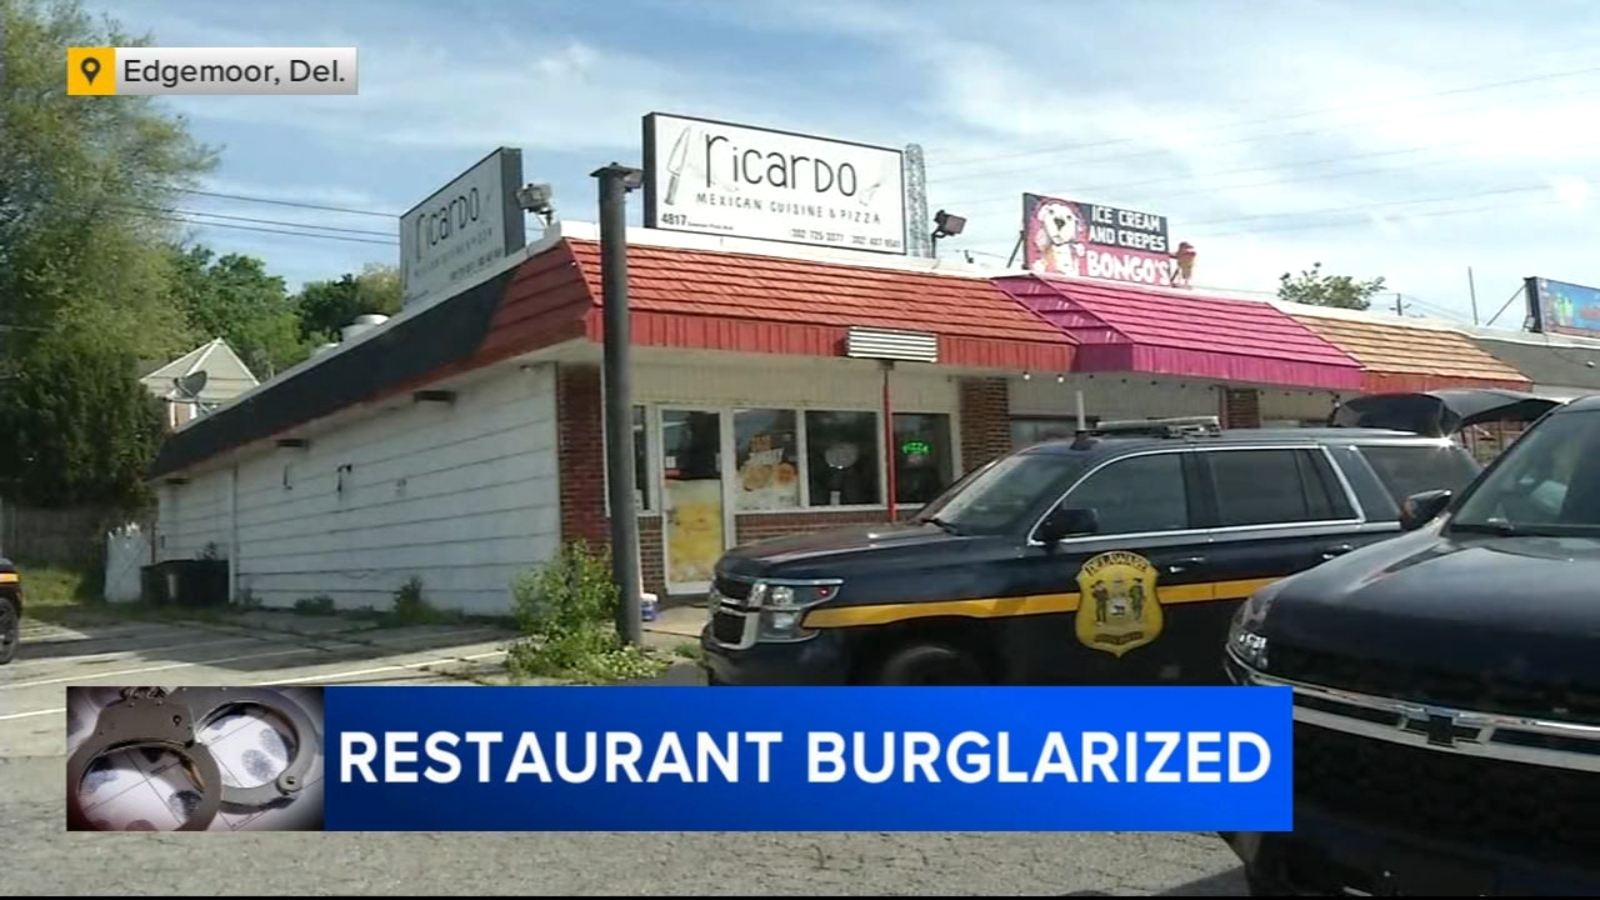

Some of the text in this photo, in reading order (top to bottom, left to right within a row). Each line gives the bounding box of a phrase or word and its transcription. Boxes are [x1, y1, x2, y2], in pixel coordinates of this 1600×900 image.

[661, 213, 687, 226] 4817
[697, 193, 763, 210] MEXICAN
[770, 201, 823, 218] CUISINE
[841, 209, 881, 224] PIZZA
[1092, 206, 1160, 231] ICE CREAM
[1089, 226, 1165, 250] AND CREPES
[1086, 251, 1169, 285] BONGO'S
